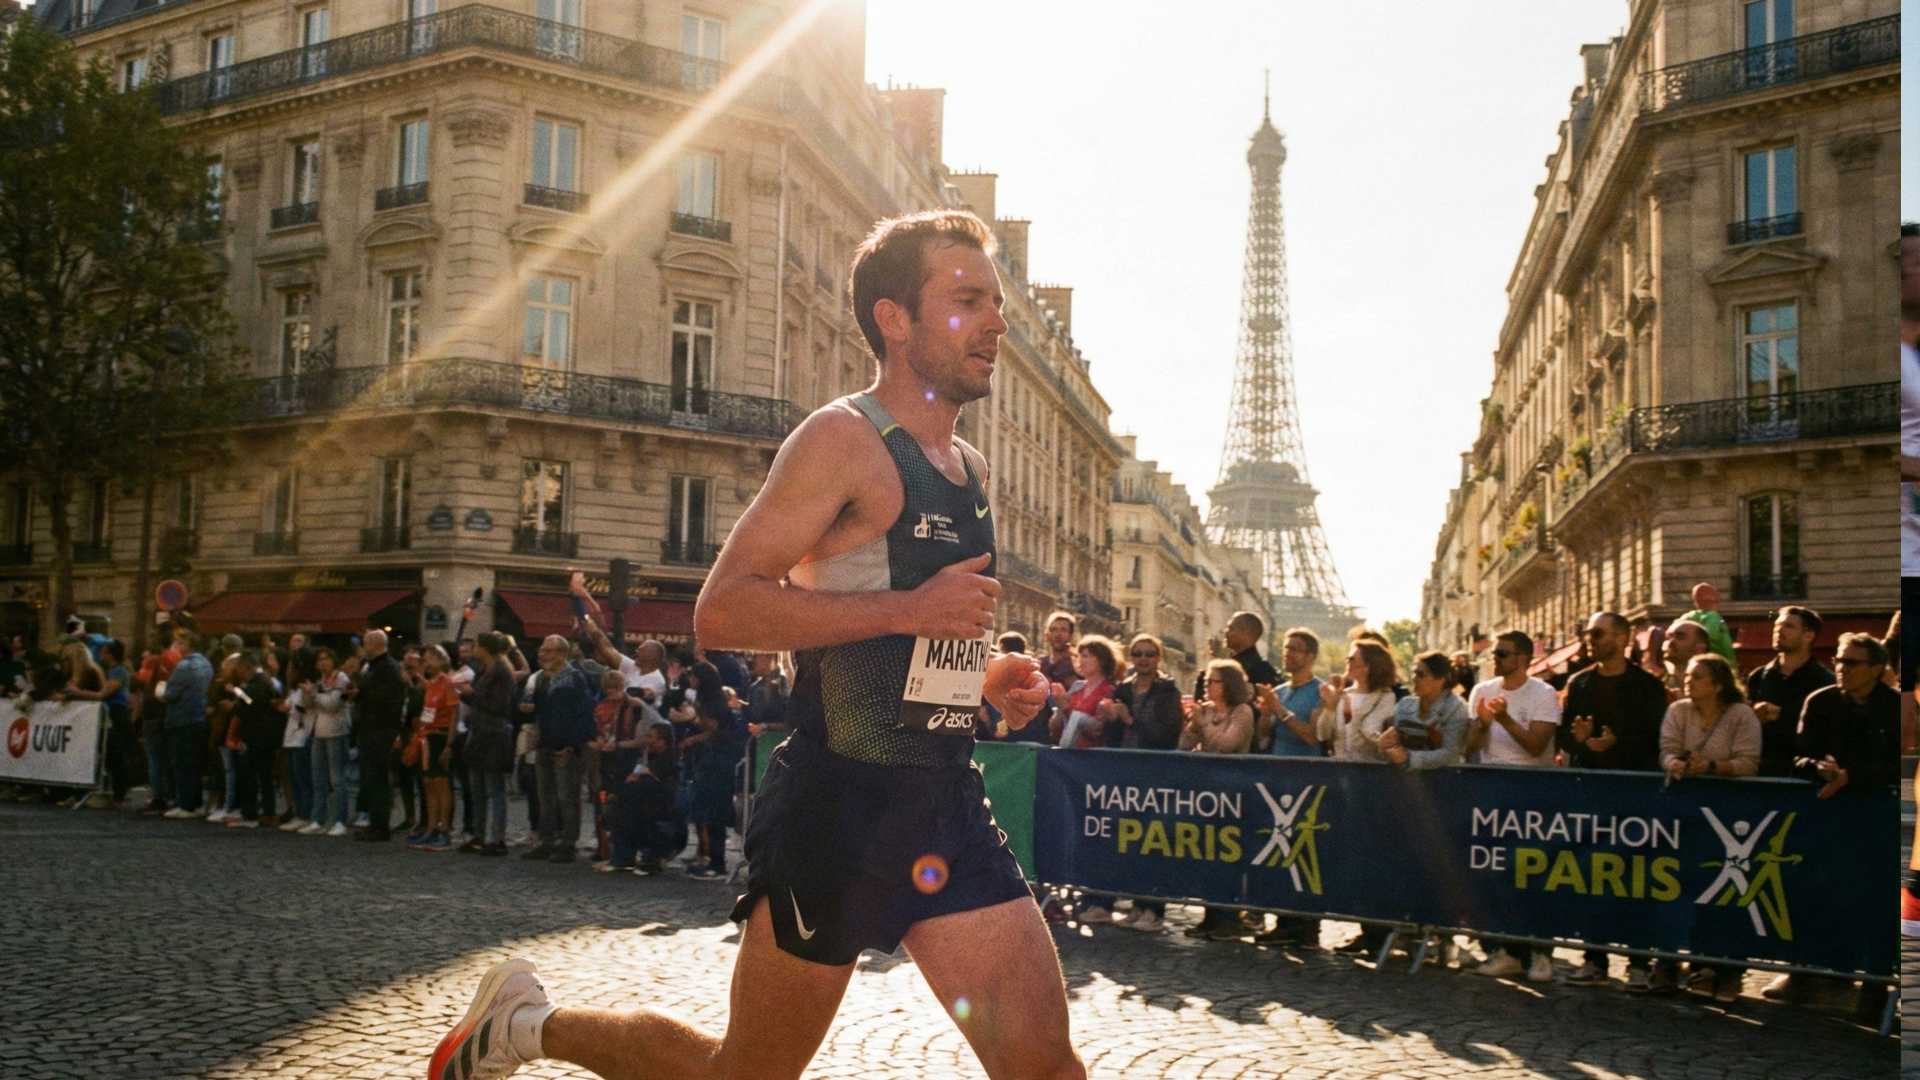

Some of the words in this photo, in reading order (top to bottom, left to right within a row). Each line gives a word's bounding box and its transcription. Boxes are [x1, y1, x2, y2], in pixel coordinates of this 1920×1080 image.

[33, 725, 72, 752] UWF
[945, 712, 974, 728] asics
[1085, 784, 1242, 819] MARATHON
[1084, 816, 1112, 838] DE
[1118, 818, 1242, 863] PARIS
[1471, 807, 1681, 850] MARATHON
[1470, 845, 1506, 870] DE
[1515, 848, 1681, 901] PARIS
